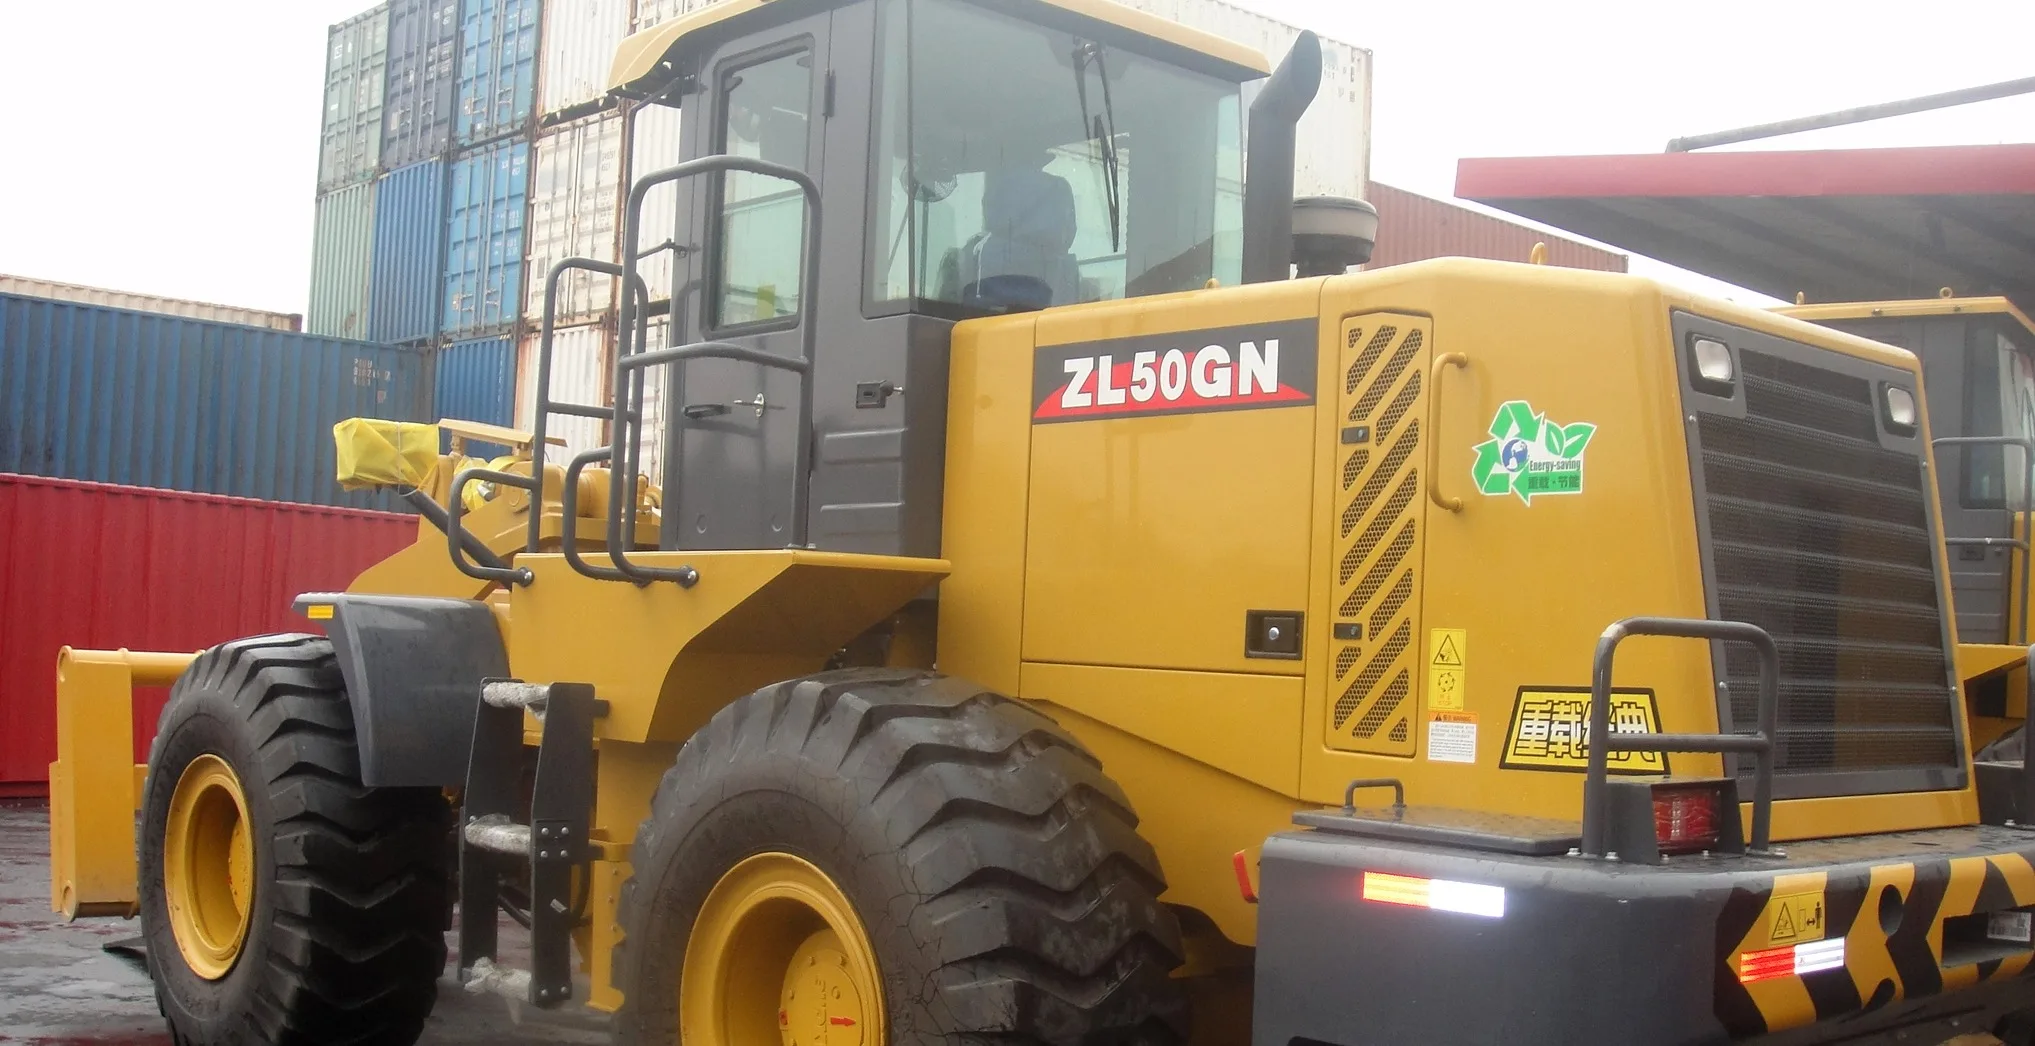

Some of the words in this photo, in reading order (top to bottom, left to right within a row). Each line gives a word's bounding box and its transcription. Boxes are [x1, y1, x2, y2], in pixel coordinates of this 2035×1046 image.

[1061, 339, 1280, 408] ZL50GN
[1529, 460, 1581, 472] Energy-saving
[1513, 699, 1656, 763] 重载典
